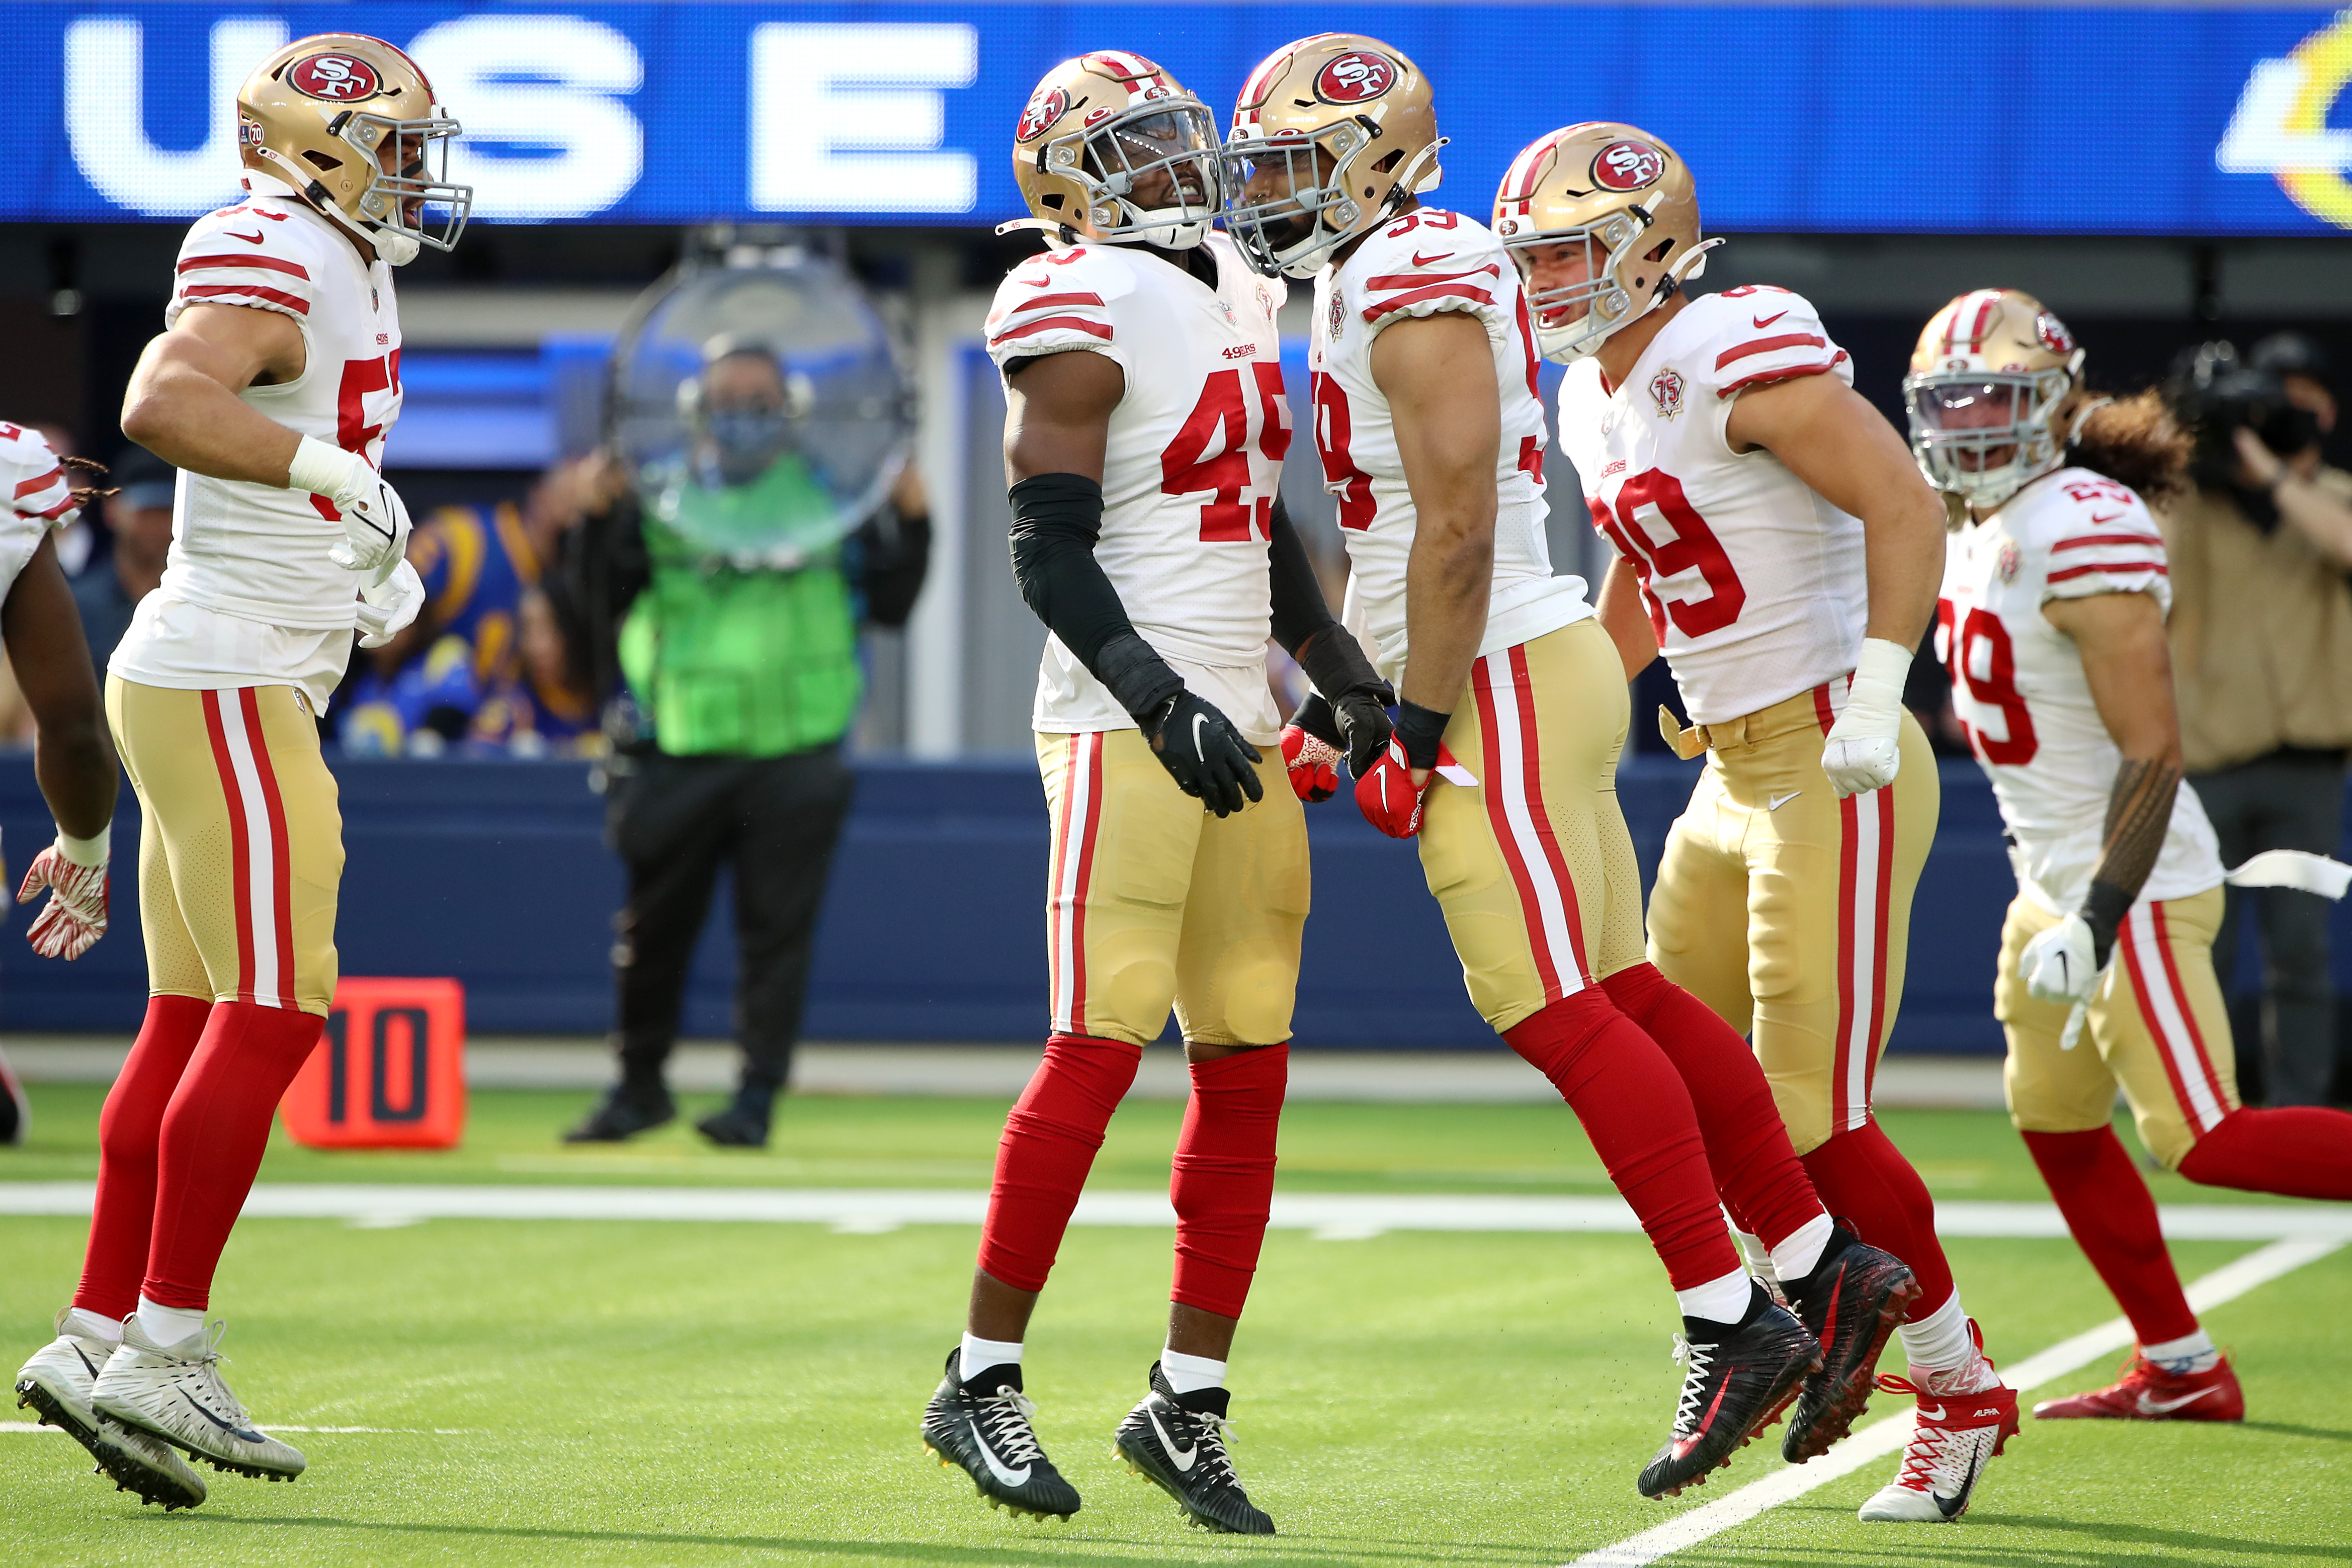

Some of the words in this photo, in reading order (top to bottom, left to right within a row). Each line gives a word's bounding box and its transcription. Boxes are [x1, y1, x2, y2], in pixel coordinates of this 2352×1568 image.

[311, 57, 367, 97] SF
[1332, 56, 1386, 97] SF
[251, 127, 262, 142] 70
[1606, 145, 1655, 185] SF
[1222, 343, 1256, 360] 49ERS
[1656, 378, 1678, 403] 75
[1310, 371, 1378, 532] 9
[324, 1008, 429, 1122] 10
[1972, 1408, 2000, 1417] ALPHA
